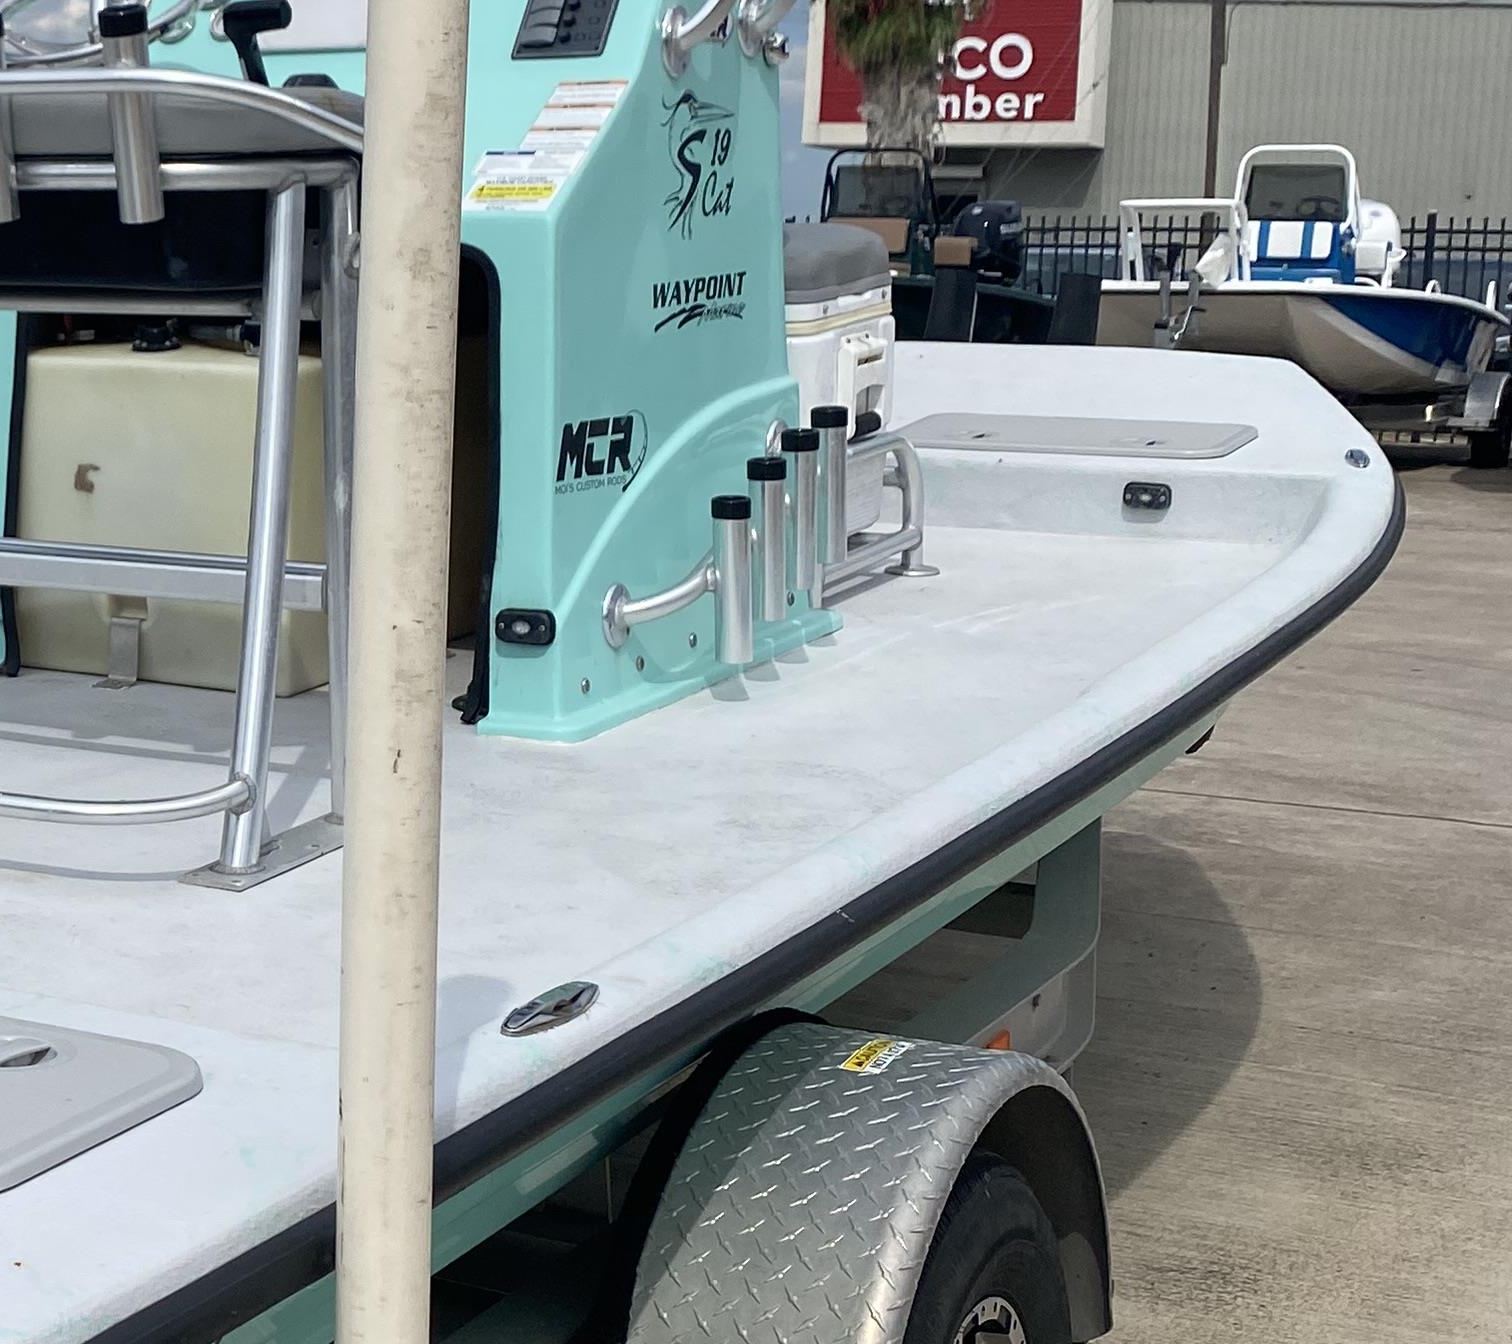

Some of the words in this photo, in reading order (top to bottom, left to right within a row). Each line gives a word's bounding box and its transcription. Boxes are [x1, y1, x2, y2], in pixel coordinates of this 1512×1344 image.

[938, 32, 1034, 81] CO
[711, 128, 732, 167] 19
[701, 169, 735, 217] Cat
[652, 270, 747, 309] WAYPOINT
[556, 415, 634, 482] MCR
[576, 478, 606, 492] CUSTOM
[607, 474, 627, 486] RODS
